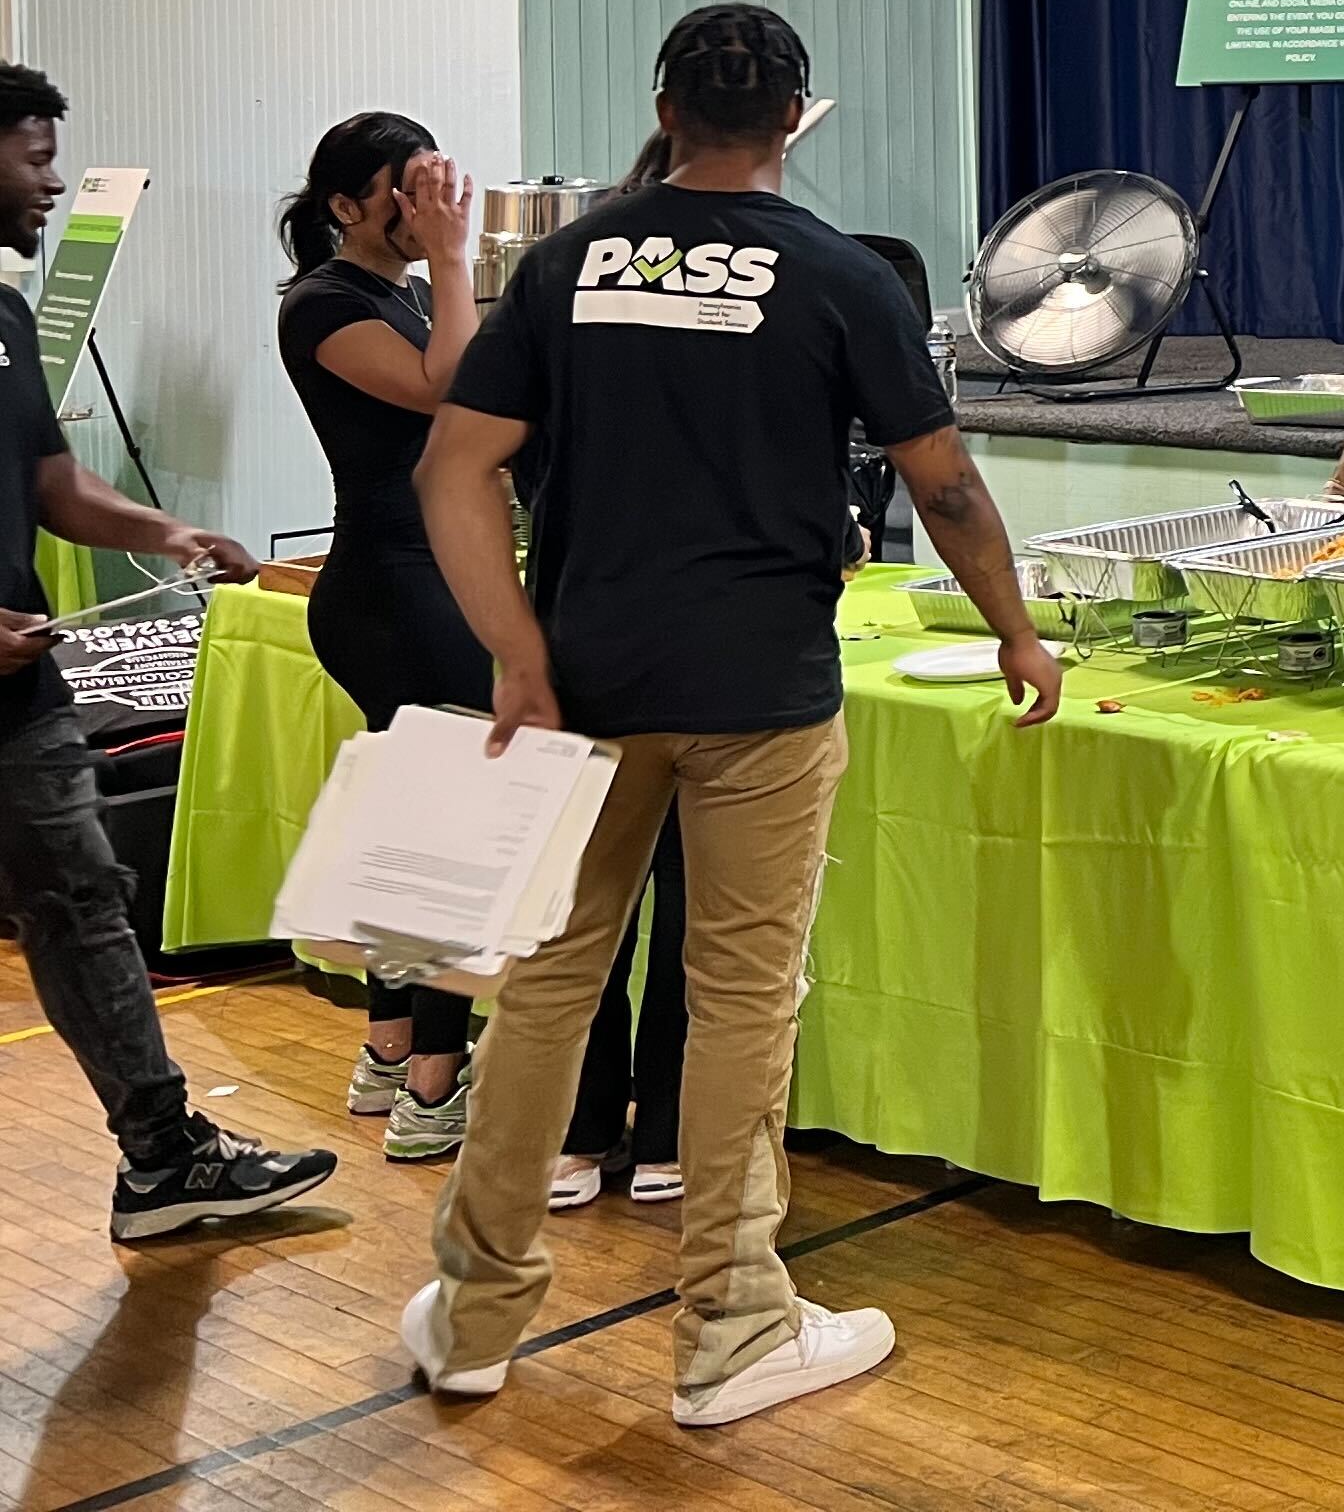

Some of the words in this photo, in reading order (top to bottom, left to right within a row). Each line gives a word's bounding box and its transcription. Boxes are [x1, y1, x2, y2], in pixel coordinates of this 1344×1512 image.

[1261, 0, 1280, 7] AND
[1269, 12, 1286, 21] THE
[1316, 11, 1334, 20] YOU
[1236, 27, 1253, 36] THE
[1271, 26, 1285, 35] OF
[1285, 26, 1308, 34] YOUR
[1282, 39, 1339, 48] ACCORDANCE
[576, 236, 780, 297] PASS
[85, 628, 203, 654] DELIVERY
[67, 670, 194, 689] COLOMBIANA
